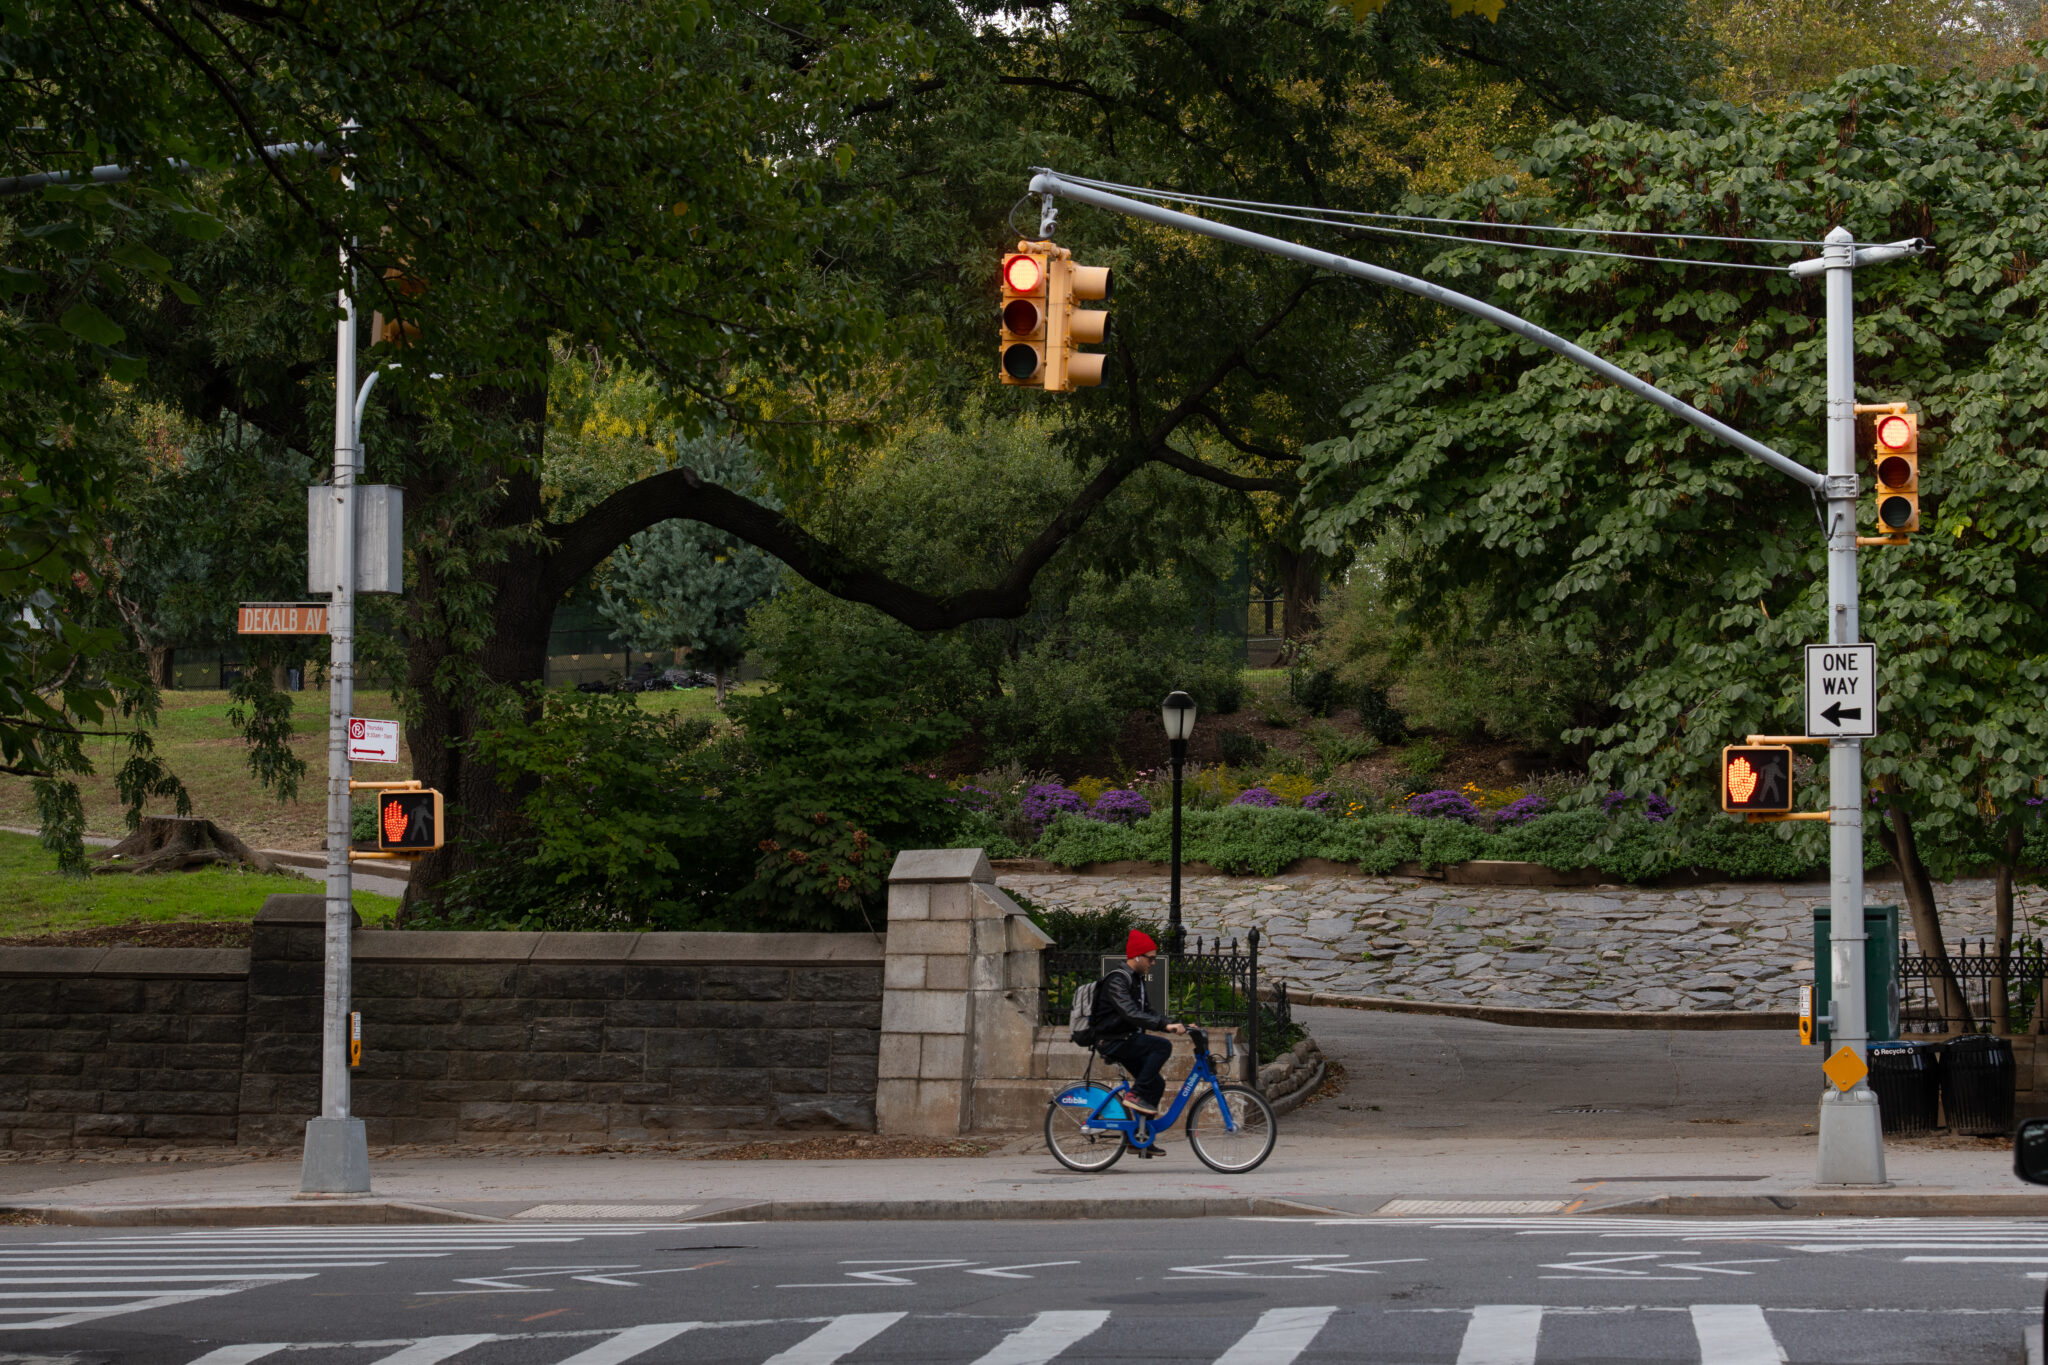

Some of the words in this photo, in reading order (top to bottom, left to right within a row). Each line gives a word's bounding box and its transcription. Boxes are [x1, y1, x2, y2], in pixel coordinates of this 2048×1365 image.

[244, 608, 298, 631] DEKALB
[305, 608, 322, 631] AV
[1823, 653, 1858, 671] ONE
[1822, 677, 1859, 695] WAY
